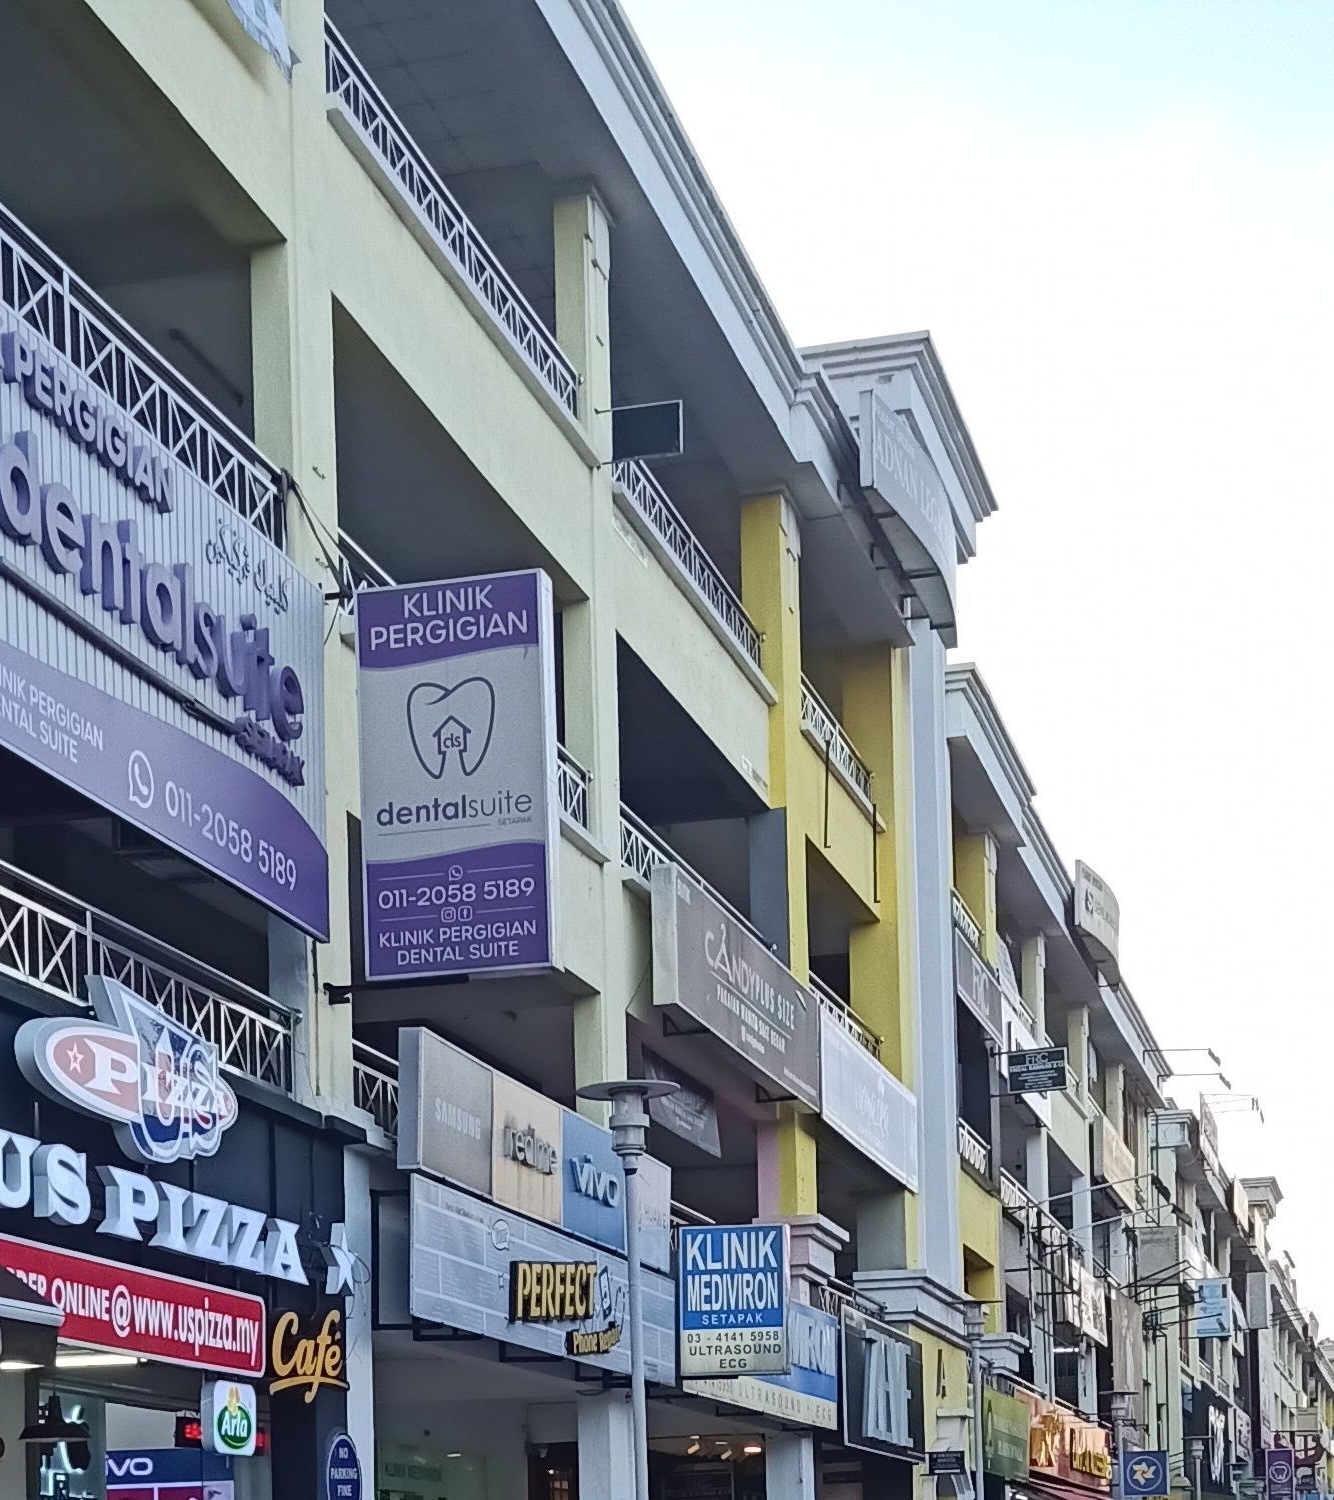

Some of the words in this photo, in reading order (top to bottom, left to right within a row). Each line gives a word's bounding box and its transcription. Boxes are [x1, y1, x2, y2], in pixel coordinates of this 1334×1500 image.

[3, 332, 173, 513] PERGIGIAN
[403, 584, 494, 619] KLINIK
[370, 609, 529, 651] PERGIGIAN
[29, 683, 103, 752] PERGIGIAN
[39, 721, 79, 764] SUITE
[376, 790, 533, 827] dentalsuite
[164, 780, 253, 864] 011-2058
[257, 839, 298, 892] 5189
[378, 881, 477, 909] 011-2058
[483, 876, 536, 899] 5189
[378, 929, 435, 948] KLINIK
[439, 918, 538, 943] PERGIGIAN
[396, 945, 464, 966] DENTAL
[469, 939, 520, 960] SUITE
[777, 993, 796, 1031] SIZE
[118, 988, 220, 1157] US
[435, 1096, 481, 1141] SAMSUNG
[569, 1153, 619, 1208] vivo
[96, 1164, 309, 1287] PIZZA
[686, 1230, 778, 1271] KLINIK
[516, 1262, 598, 1319] PERFECT
[687, 1272, 779, 1312] MEDIVIRON
[687, 1333, 701, 1344] 03
[716, 1331, 744, 1342] 4141
[750, 1330, 780, 1342] 5958
[702, 1312, 764, 1325] SETAPAK
[271, 1309, 343, 1400] Café
[573, 1331, 598, 1355] Phone
[689, 1342, 782, 1356] ULTRASOUND
[719, 1358, 748, 1370] ECG
[221, 1411, 248, 1438] Arla
[338, 1446, 349, 1459] NO
[330, 1467, 358, 1480] PARKING
[337, 1484, 353, 1497] FINE
